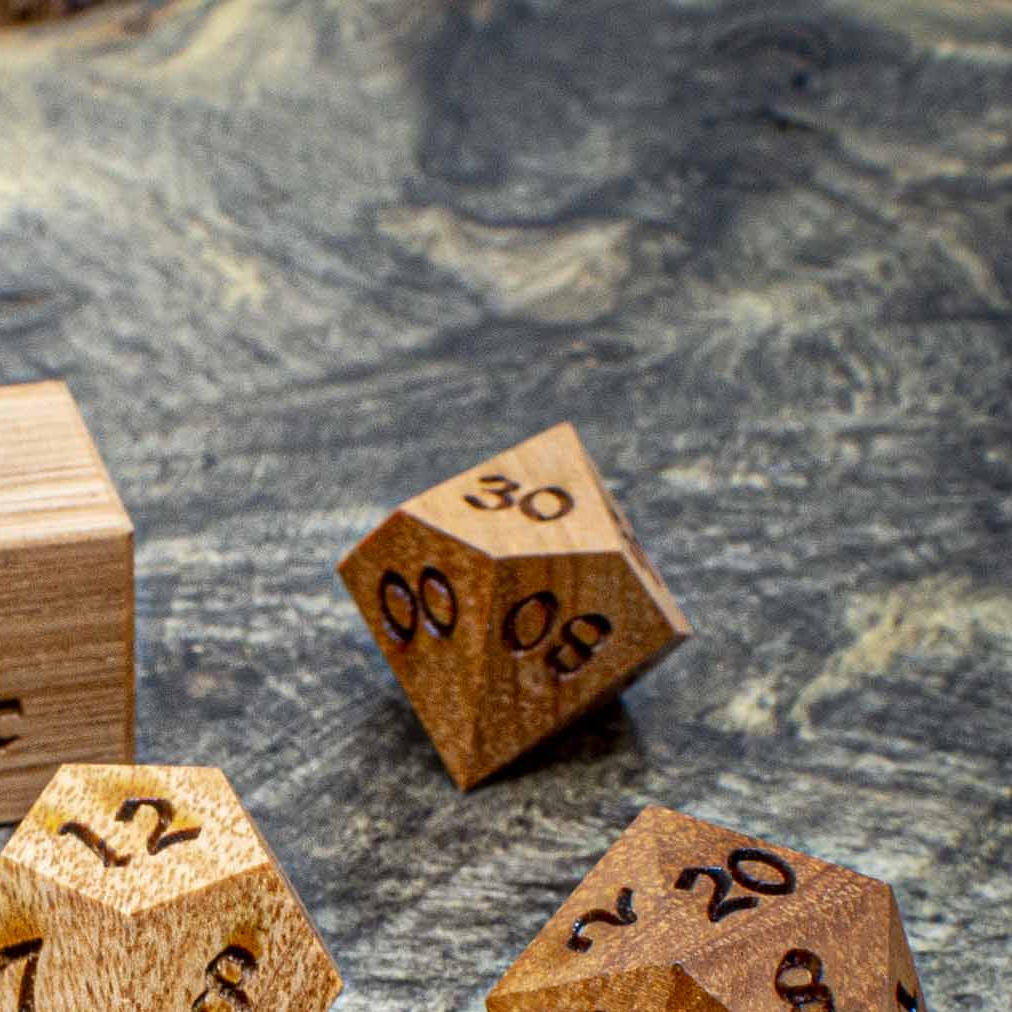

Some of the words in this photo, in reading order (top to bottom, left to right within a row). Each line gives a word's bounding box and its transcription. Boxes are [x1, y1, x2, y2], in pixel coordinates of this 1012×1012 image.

[464, 475, 574, 521] 30
[379, 565, 458, 644] 00
[59, 798, 201, 867] 12
[674, 848, 796, 922] 20
